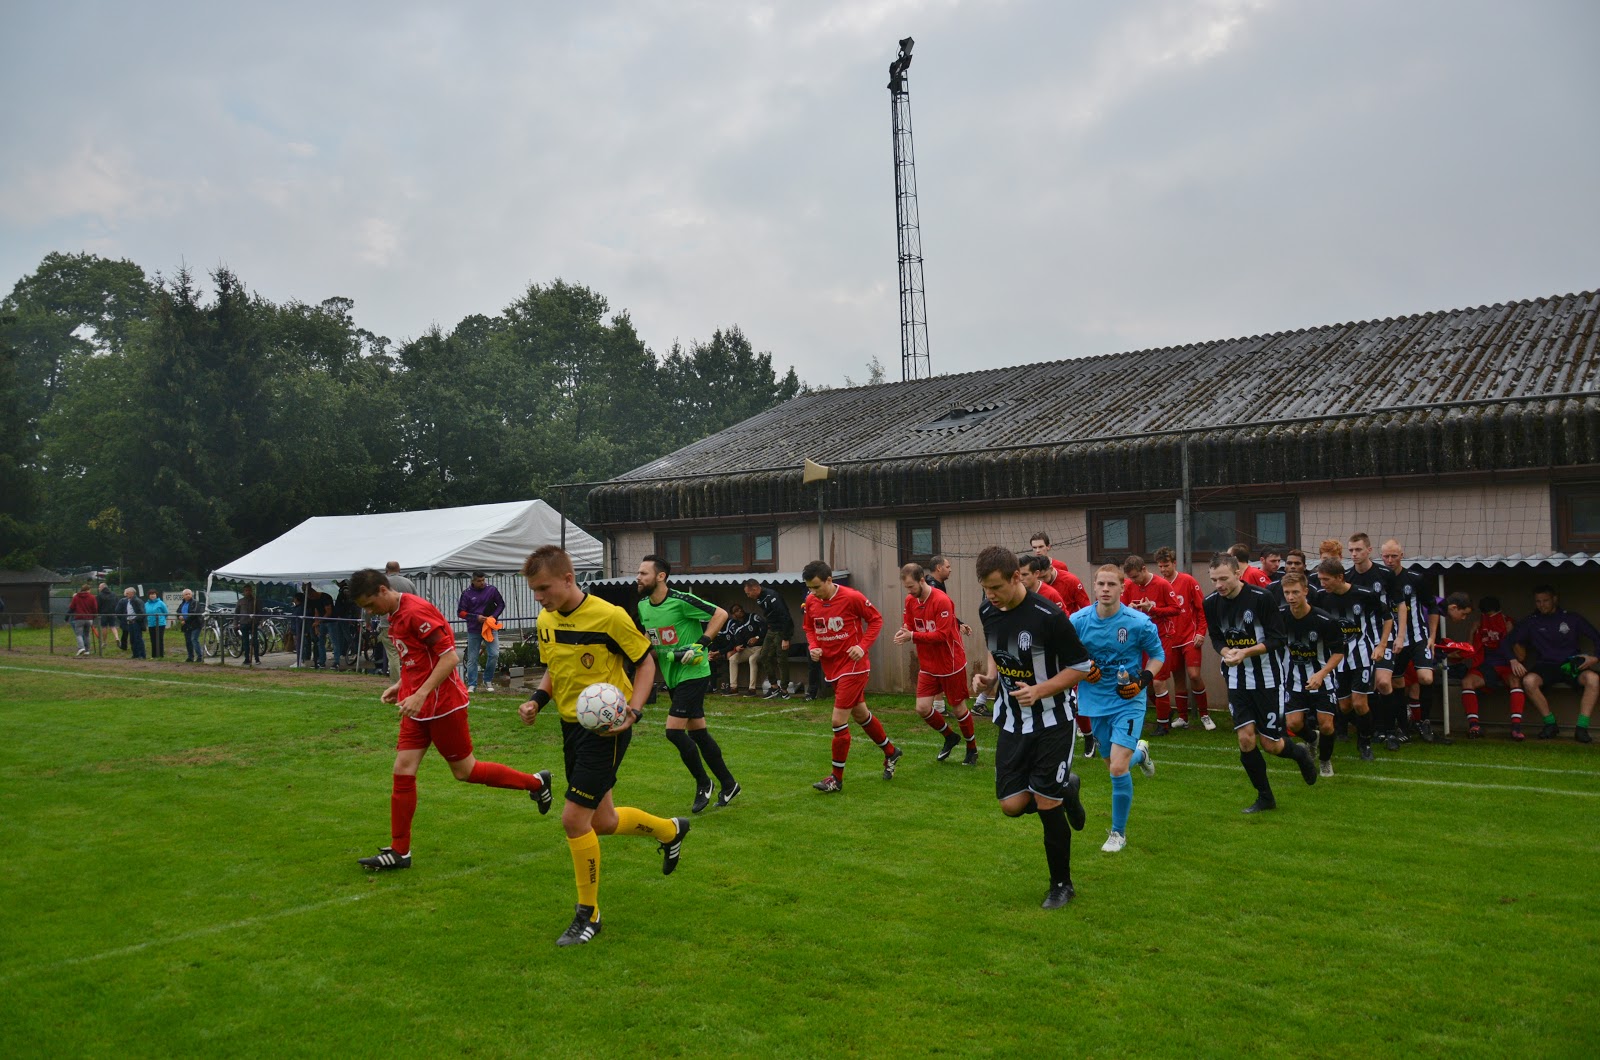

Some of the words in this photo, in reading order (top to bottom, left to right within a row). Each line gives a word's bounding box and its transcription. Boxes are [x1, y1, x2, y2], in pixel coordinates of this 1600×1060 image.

[1383, 648, 1392, 660] 5
[1361, 669, 1370, 684] 9
[1126, 719, 1134, 736] 1
[1266, 711, 1277, 729] 2
[1055, 760, 1067, 784] 6
